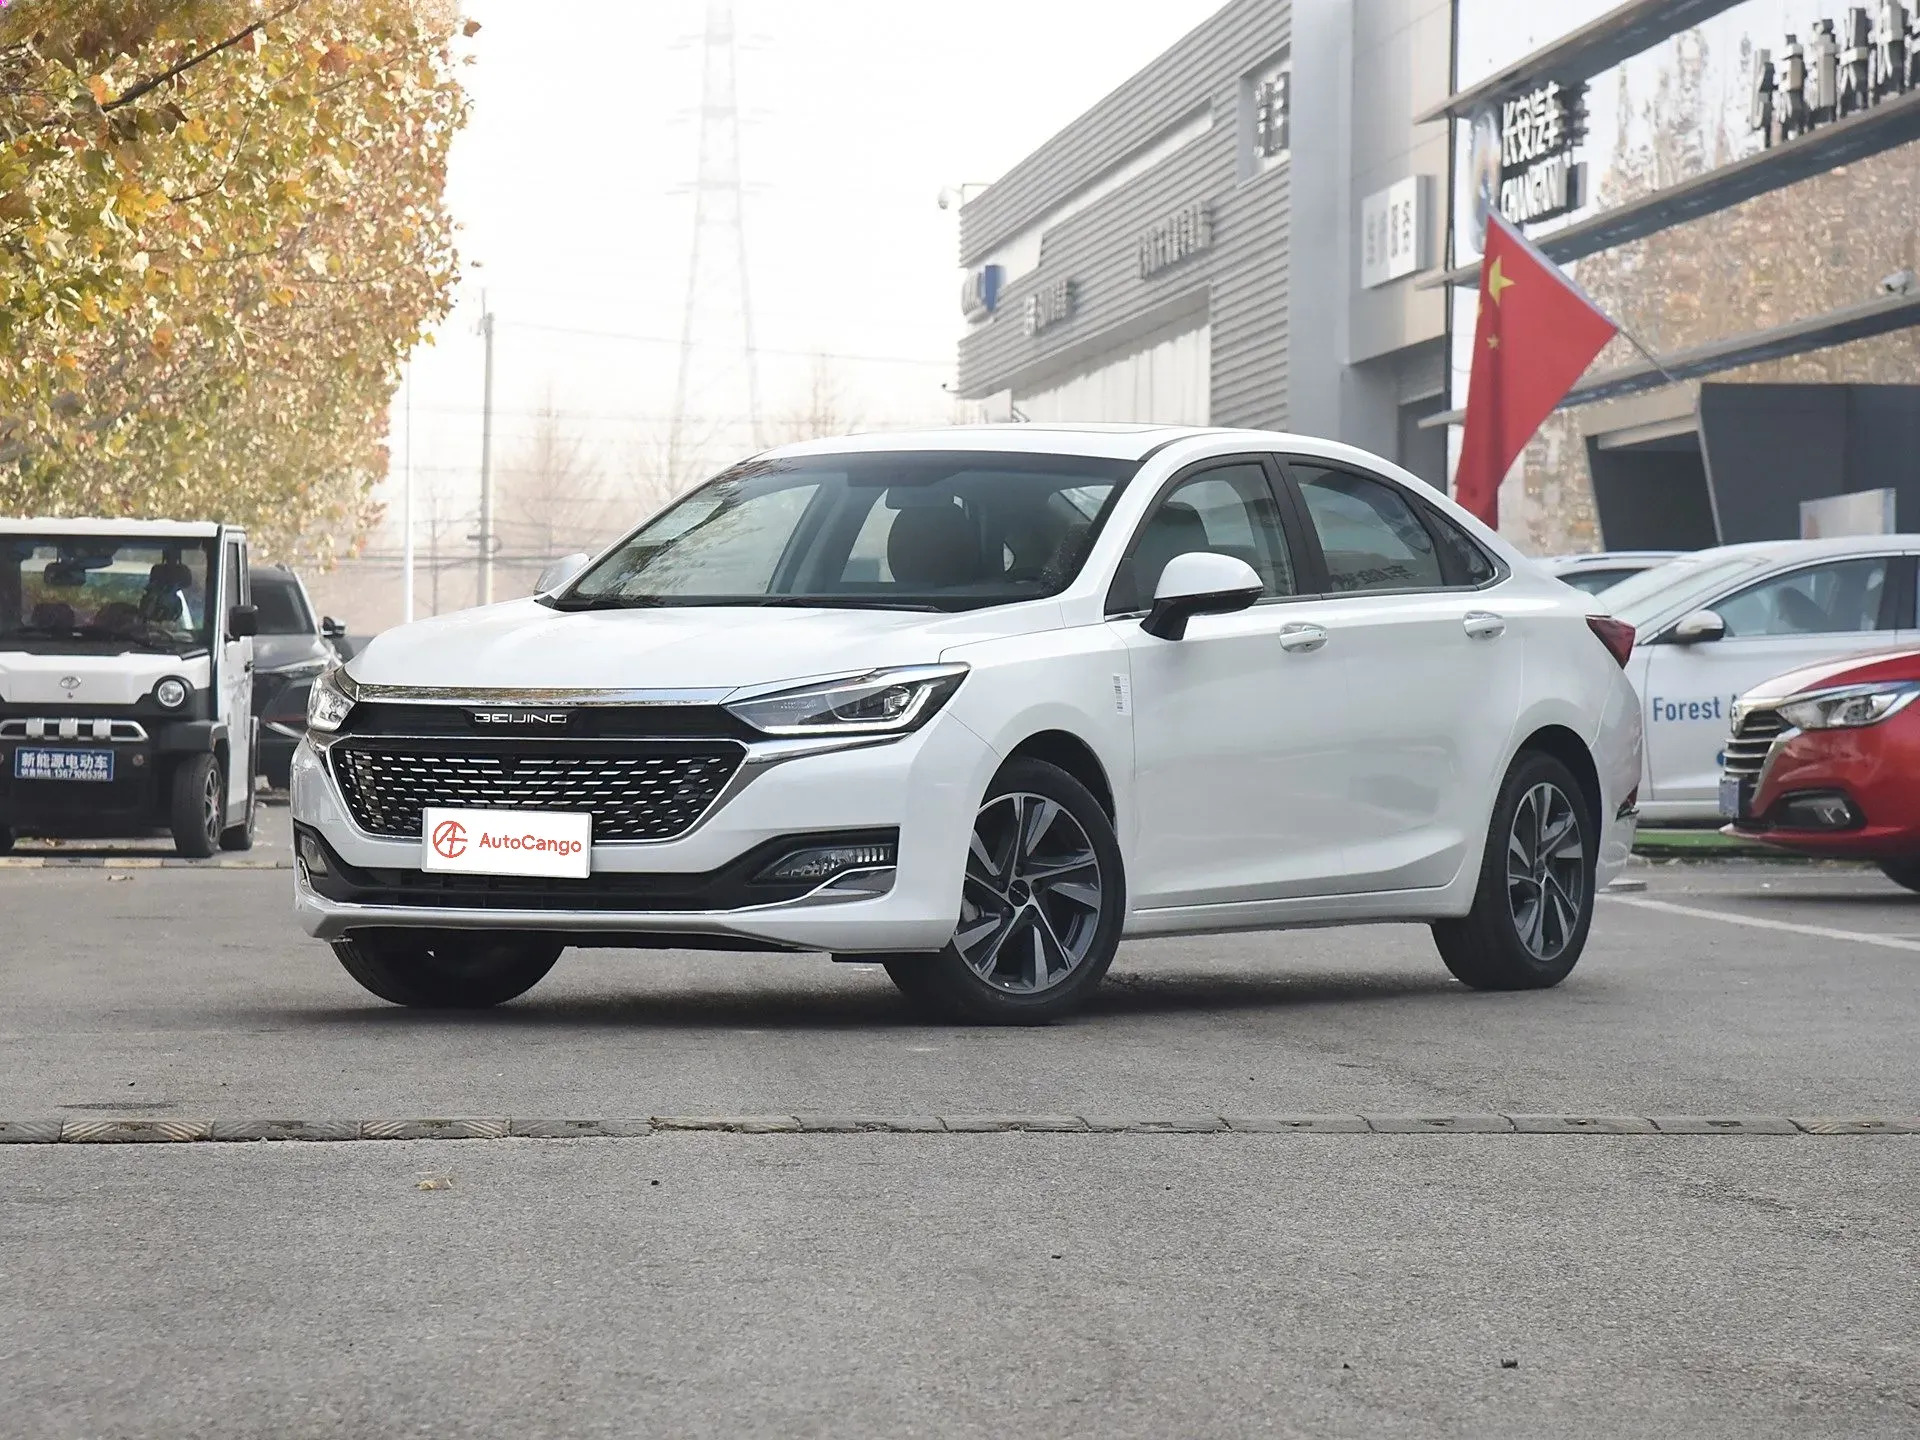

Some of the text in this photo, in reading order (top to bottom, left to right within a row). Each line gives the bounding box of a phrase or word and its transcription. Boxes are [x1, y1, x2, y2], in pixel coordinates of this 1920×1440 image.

[1652, 696, 1721, 722] Forest
[474, 713, 567, 724] BEIJING
[21, 752, 108, 770] 新能源电动车
